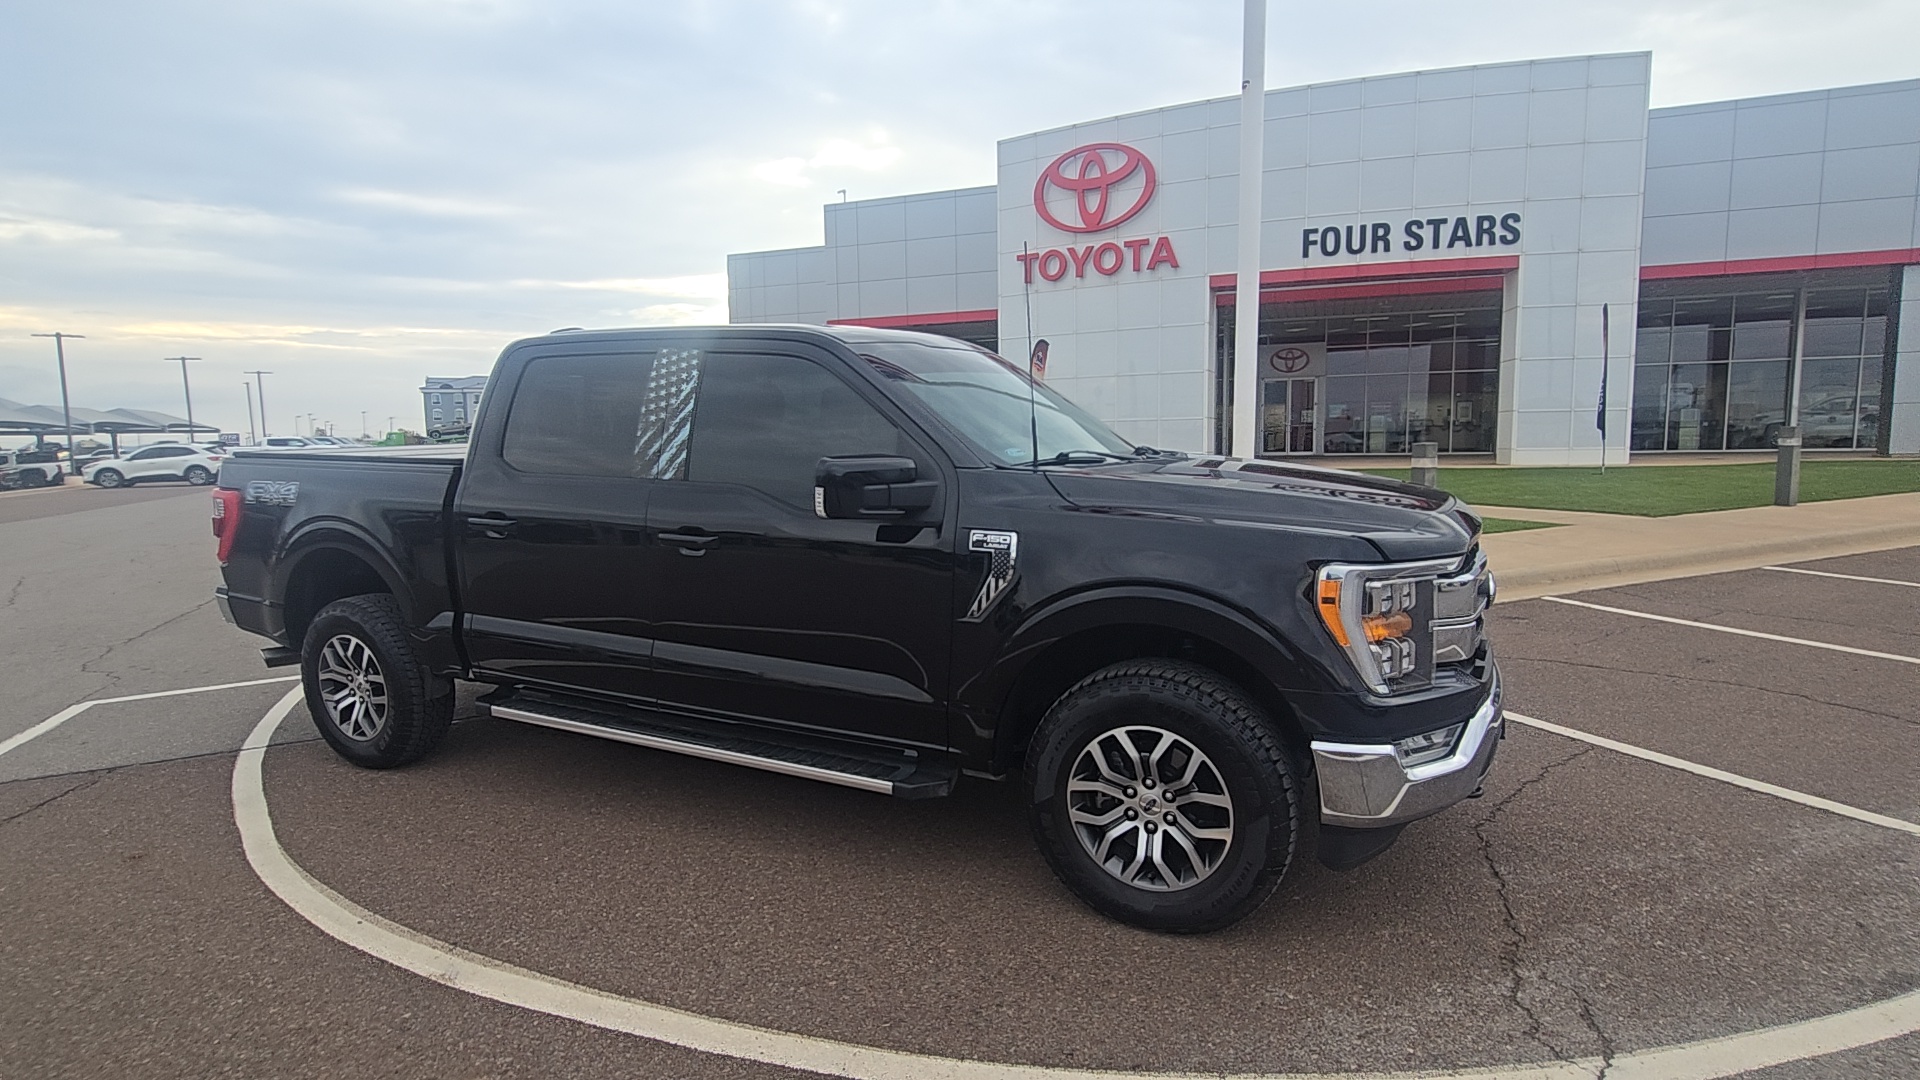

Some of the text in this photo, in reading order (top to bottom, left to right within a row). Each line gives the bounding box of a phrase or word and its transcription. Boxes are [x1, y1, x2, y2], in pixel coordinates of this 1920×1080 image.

[1302, 213, 1521, 258] FOUR STARS
[1016, 236, 1180, 284] TOYOTA
[245, 480, 300, 503] FX4
[973, 534, 1010, 544] F-150
